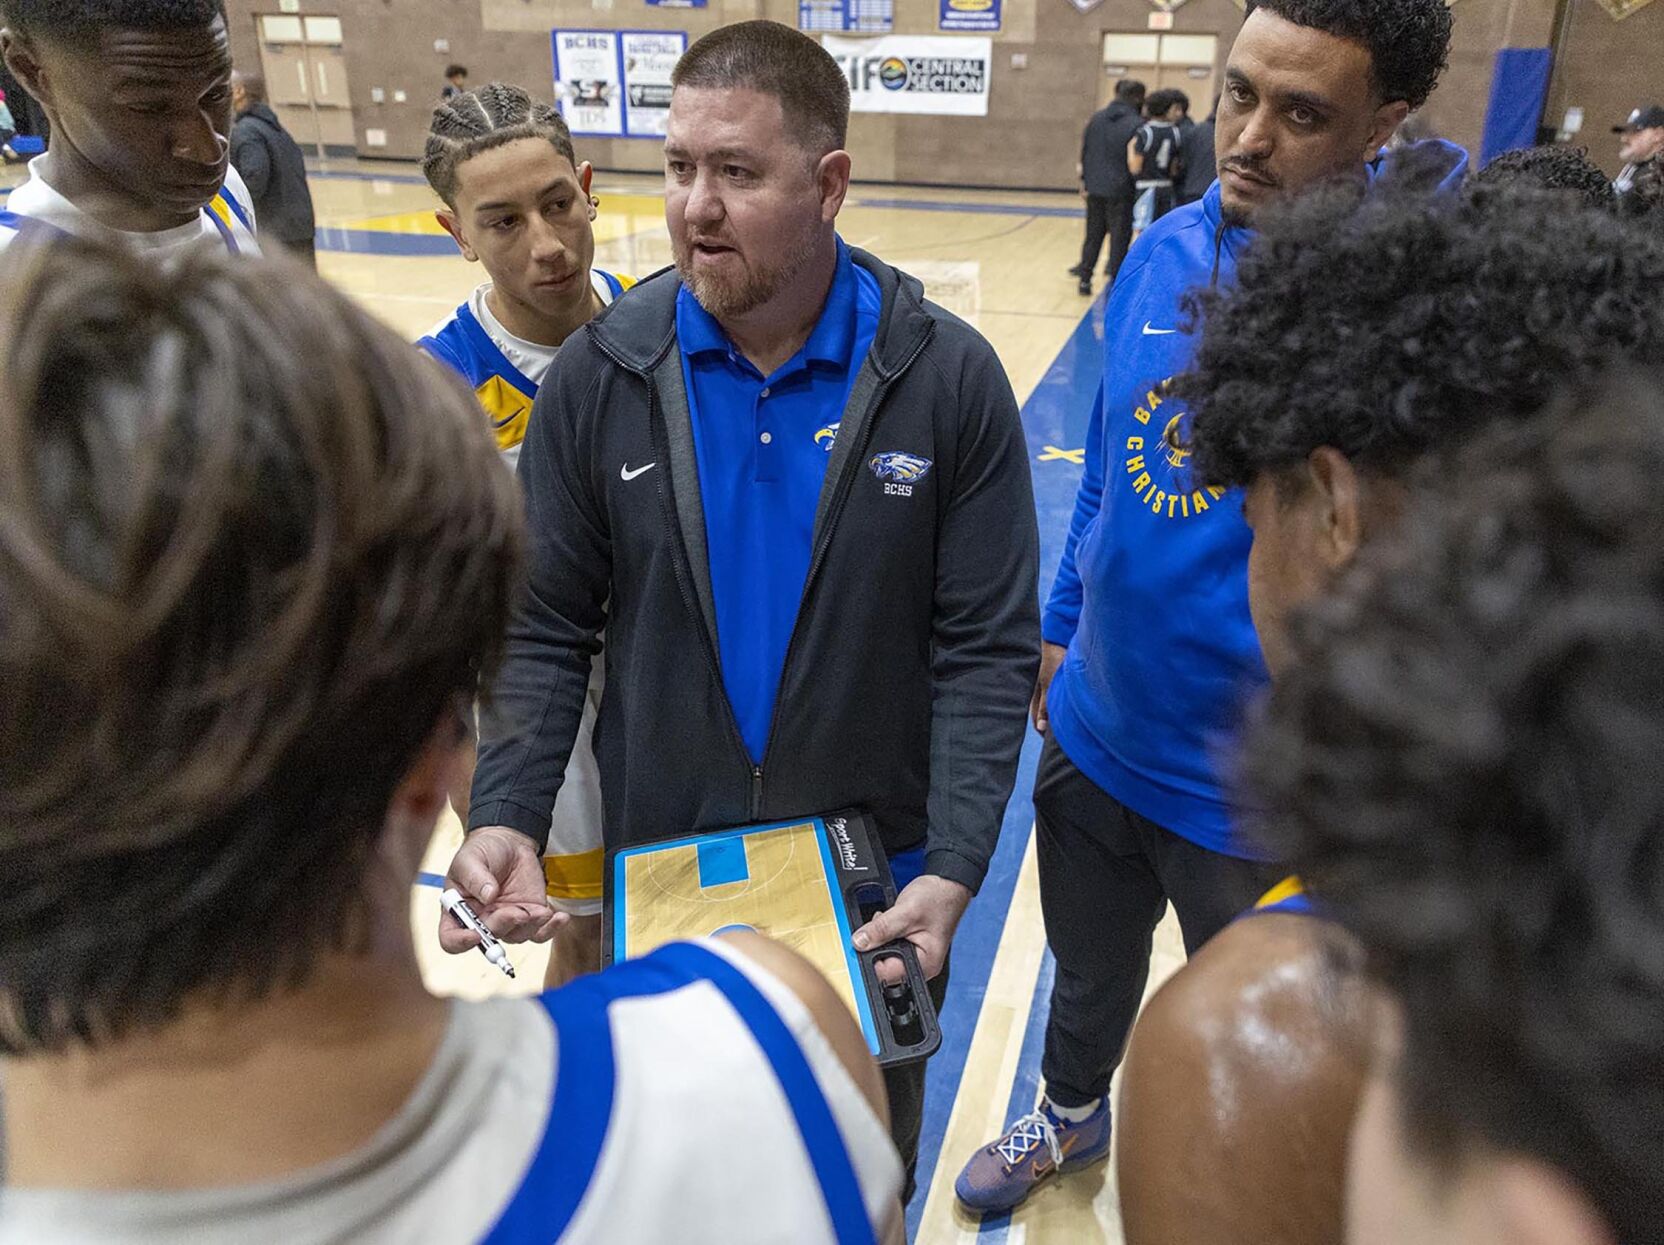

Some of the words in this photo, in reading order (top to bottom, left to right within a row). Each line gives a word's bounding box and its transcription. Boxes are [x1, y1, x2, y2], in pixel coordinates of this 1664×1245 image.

[565, 37, 609, 50] BCHS
[836, 56, 882, 90] IF
[911, 59, 982, 76] CENTRAL
[910, 75, 983, 93] SECTION
[884, 482, 913, 497] BCHS
